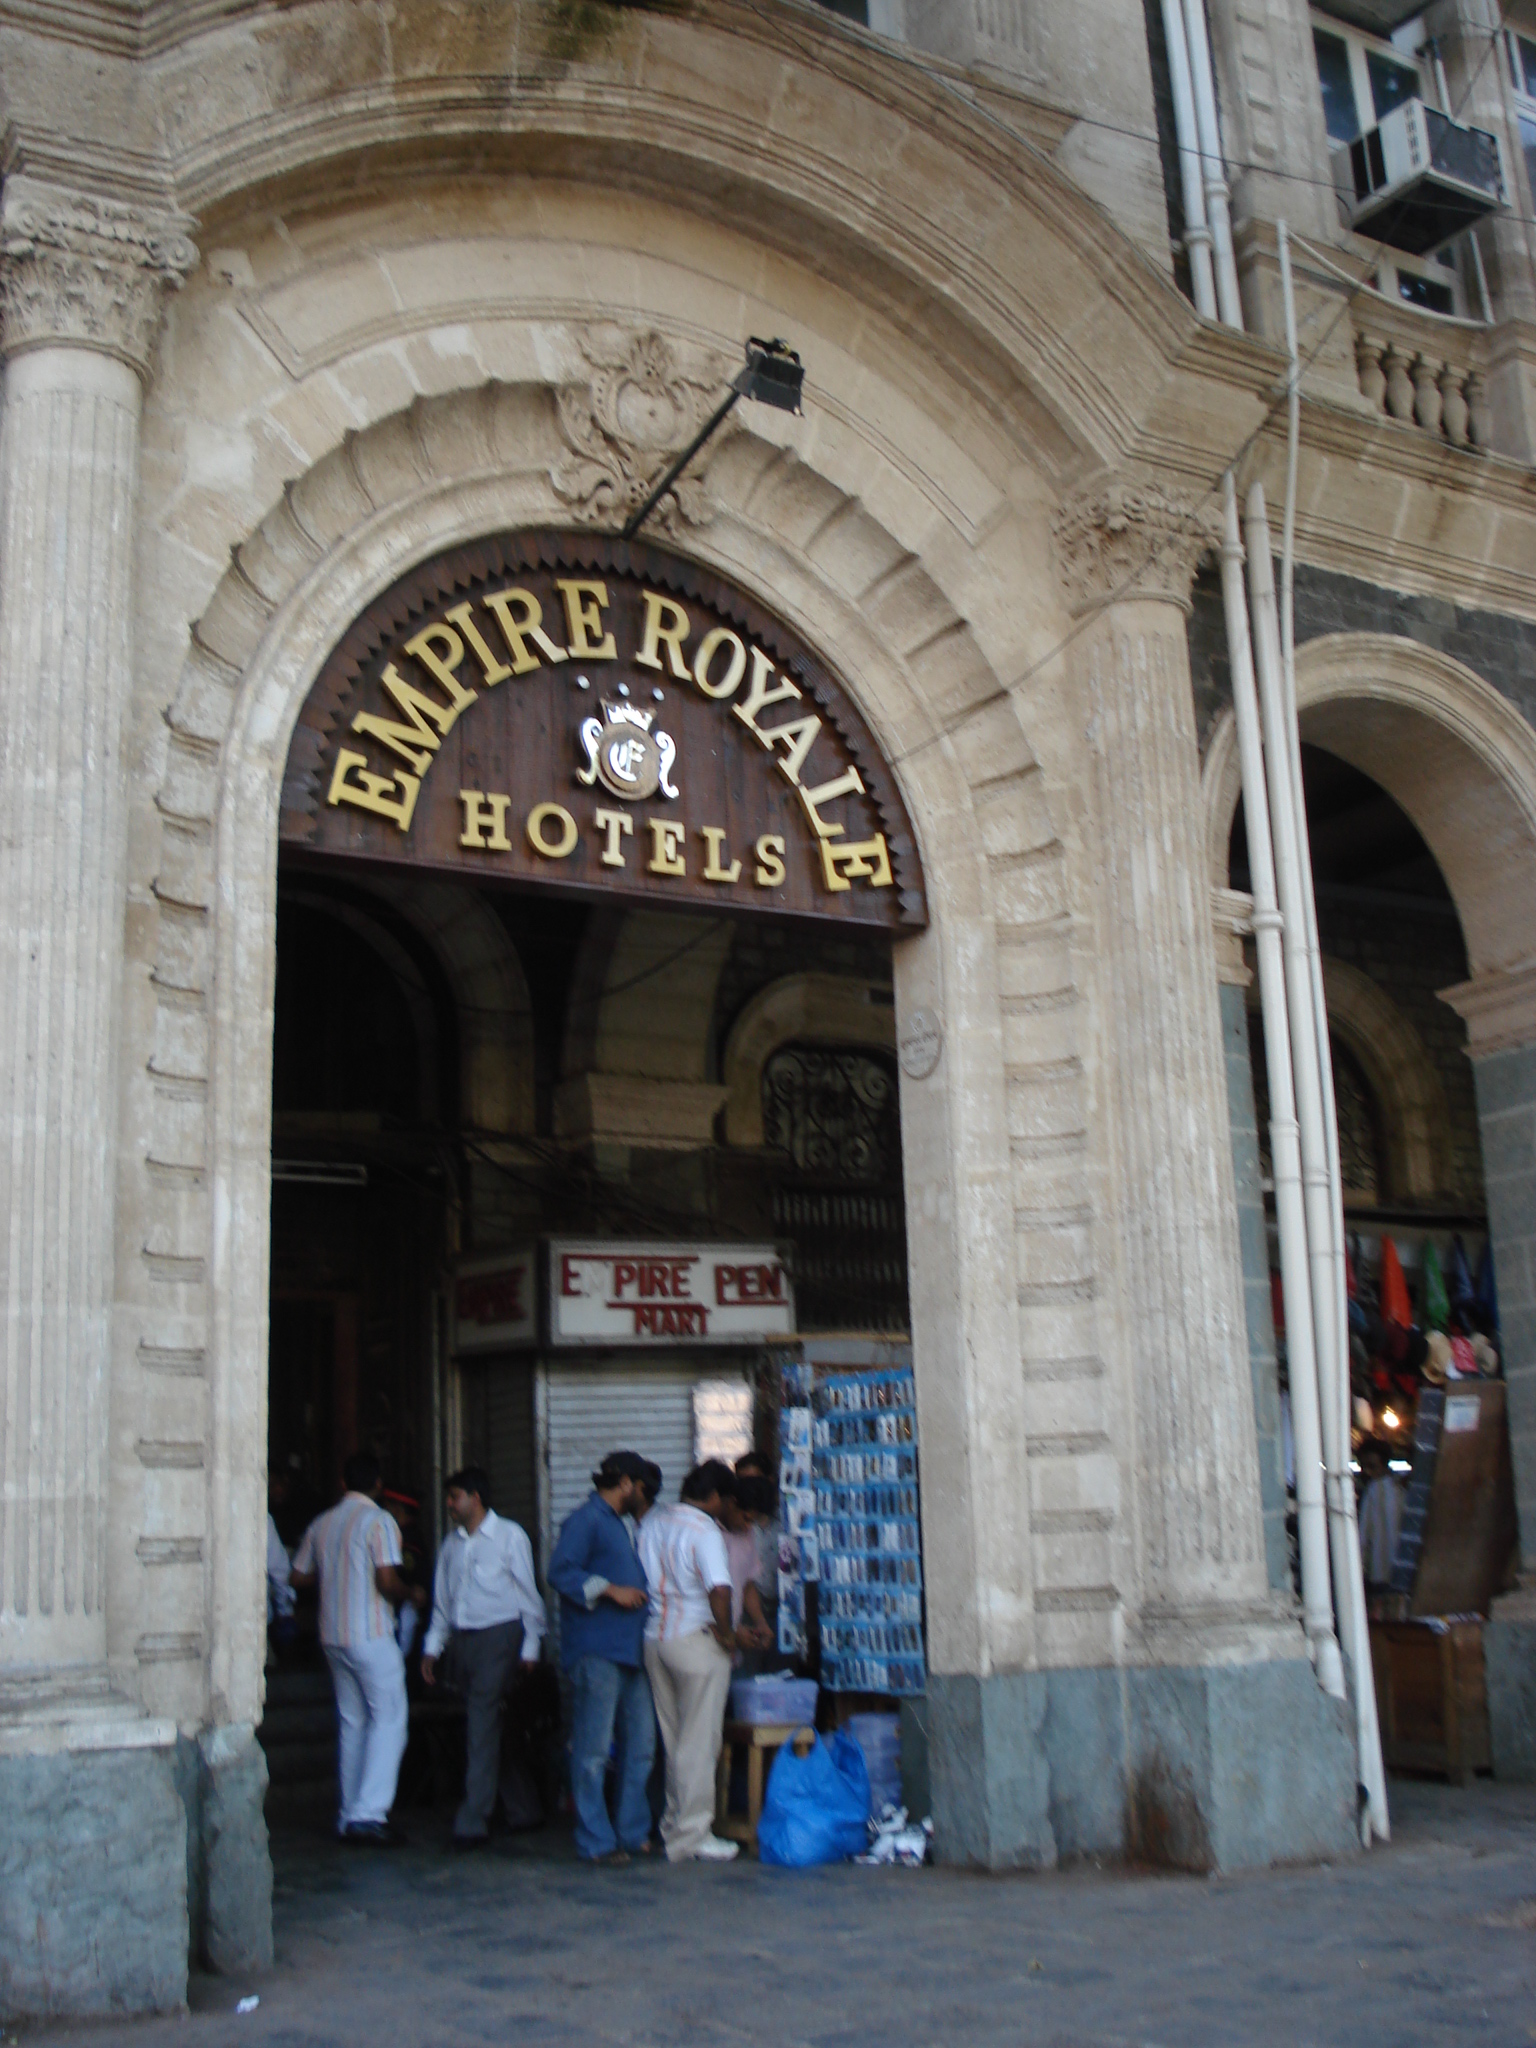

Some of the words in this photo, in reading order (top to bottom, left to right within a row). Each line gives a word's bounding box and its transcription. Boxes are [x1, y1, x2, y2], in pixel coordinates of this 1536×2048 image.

[328, 578, 618, 831] EMPIRE
[635, 589, 894, 892] ROYALE
[459, 789, 787, 887] HOTELS
[606, 1301, 711, 1336] MART
[714, 1263, 788, 1305] PEN
